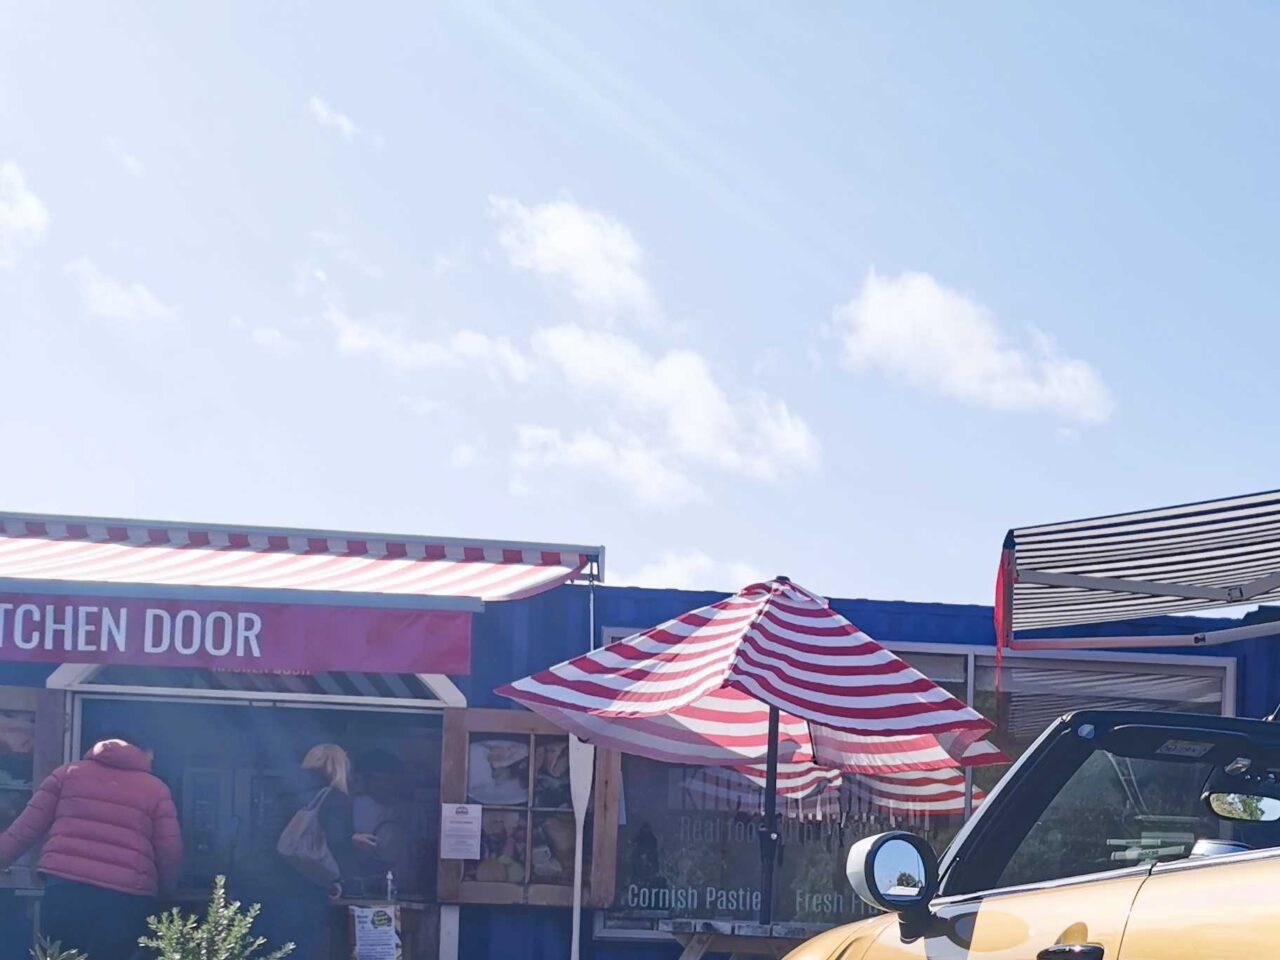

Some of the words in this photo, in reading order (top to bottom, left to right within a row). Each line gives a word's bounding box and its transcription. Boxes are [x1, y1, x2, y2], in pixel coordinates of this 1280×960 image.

[143, 608, 263, 657] DOOR
[628, 883, 698, 911] Cornish
[796, 889, 843, 913] Fresh
